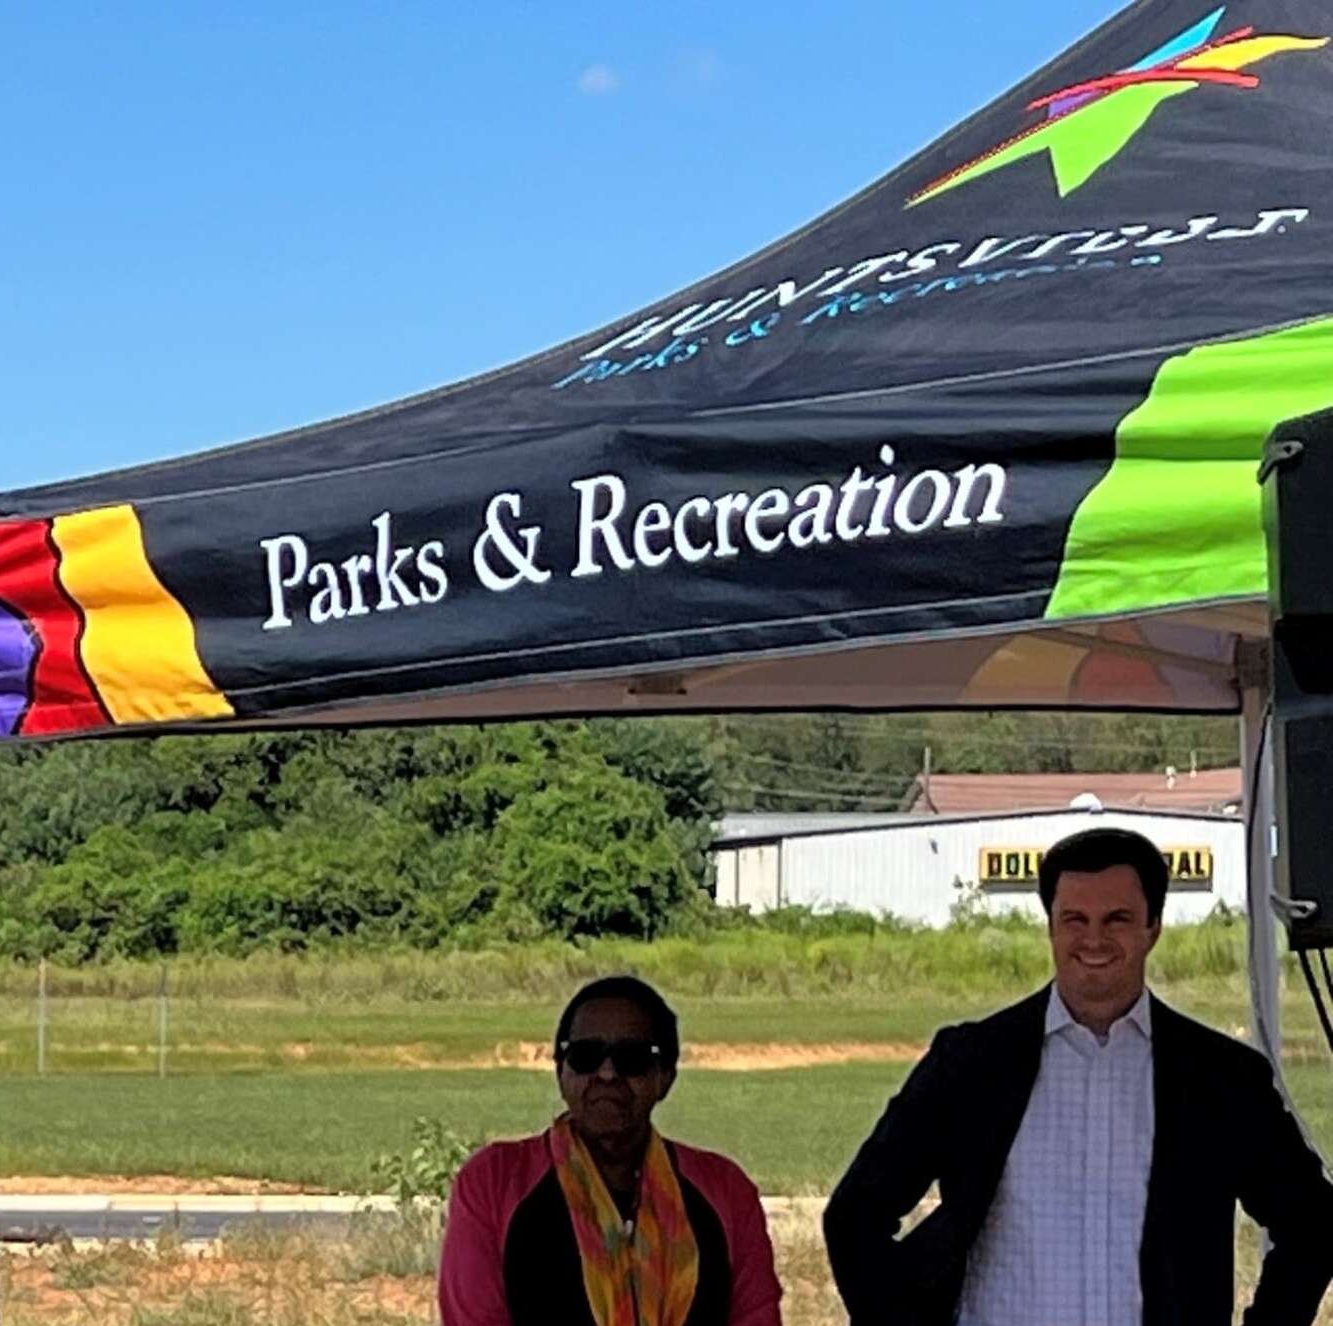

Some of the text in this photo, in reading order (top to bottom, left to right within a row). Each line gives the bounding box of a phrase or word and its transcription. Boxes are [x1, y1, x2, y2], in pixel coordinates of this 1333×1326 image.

[261, 445, 1006, 629] Parks & Recreation
